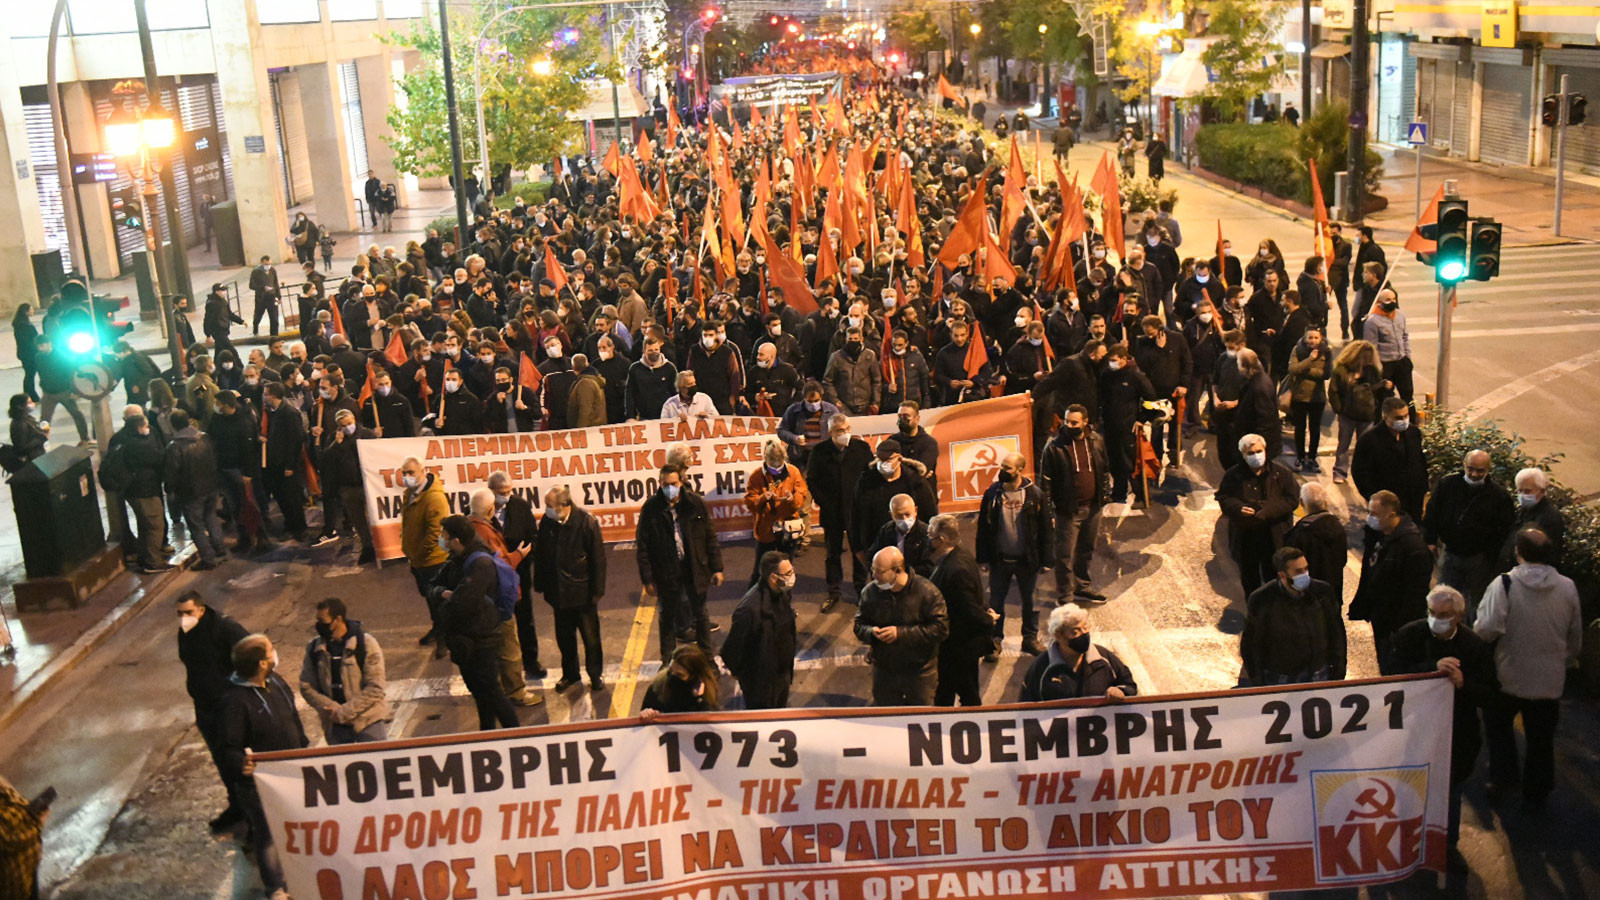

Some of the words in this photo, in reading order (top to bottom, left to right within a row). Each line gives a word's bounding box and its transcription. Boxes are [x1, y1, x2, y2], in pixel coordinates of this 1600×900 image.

[425, 430, 588, 460] ΑΠΕΜΠΛΟΚΗ
[599, 424, 648, 447] ΤΗΣ
[660, 417, 779, 443] ΕΛΛΑΔΑΣ
[379, 465, 445, 488] ΤΣ
[456, 446, 702, 484] ΙΜΠΕΡΙΑΛΙΣΤΙΚΟΣ
[714, 442, 763, 464] ΣΧΕ
[582, 473, 705, 506] ΣΥΜΦΩΣ
[715, 470, 746, 495] ΜΕ
[955, 467, 1000, 497] ΚΚ
[302, 737, 616, 808] ΝΟΕΜΒΡΗΣ
[658, 729, 799, 773] 1973
[907, 705, 1222, 767] ΝΟΕΜΒΡΗΣ
[1261, 690, 1405, 745] 2021
[284, 819, 340, 857] ΣΤΟ
[353, 806, 483, 855] ΔΡΟΜΟ
[498, 799, 562, 841] ΤΗΣ
[575, 784, 693, 834] ΠΑΛΗΣ
[740, 778, 802, 816] ΤΗΣ
[815, 776, 969, 810] ΕΛΠΙΔΑΣ
[1017, 770, 1081, 805] ΤΗΣ
[1092, 751, 1304, 802] ΑΝΑΤΡΟΠΗΣ
[362, 857, 478, 900] ΛΑΟΣ
[494, 839, 664, 897] ΜΠΟΡΕΙ
[681, 829, 744, 874] ΝΑ
[760, 818, 958, 866] ΚΕΡΔΙΣΕΙ
[975, 816, 1029, 852] ΤΟ
[1047, 805, 1172, 849] ΔΙΚΙΟ
[1188, 797, 1274, 842] ΤΟΥ
[1318, 815, 1423, 878] ΚΚΕ
[862, 864, 1077, 900] ΟΡΓΑΝΩΣΗ
[1099, 856, 1278, 891] ΑΤΤΙΚΗΣ
